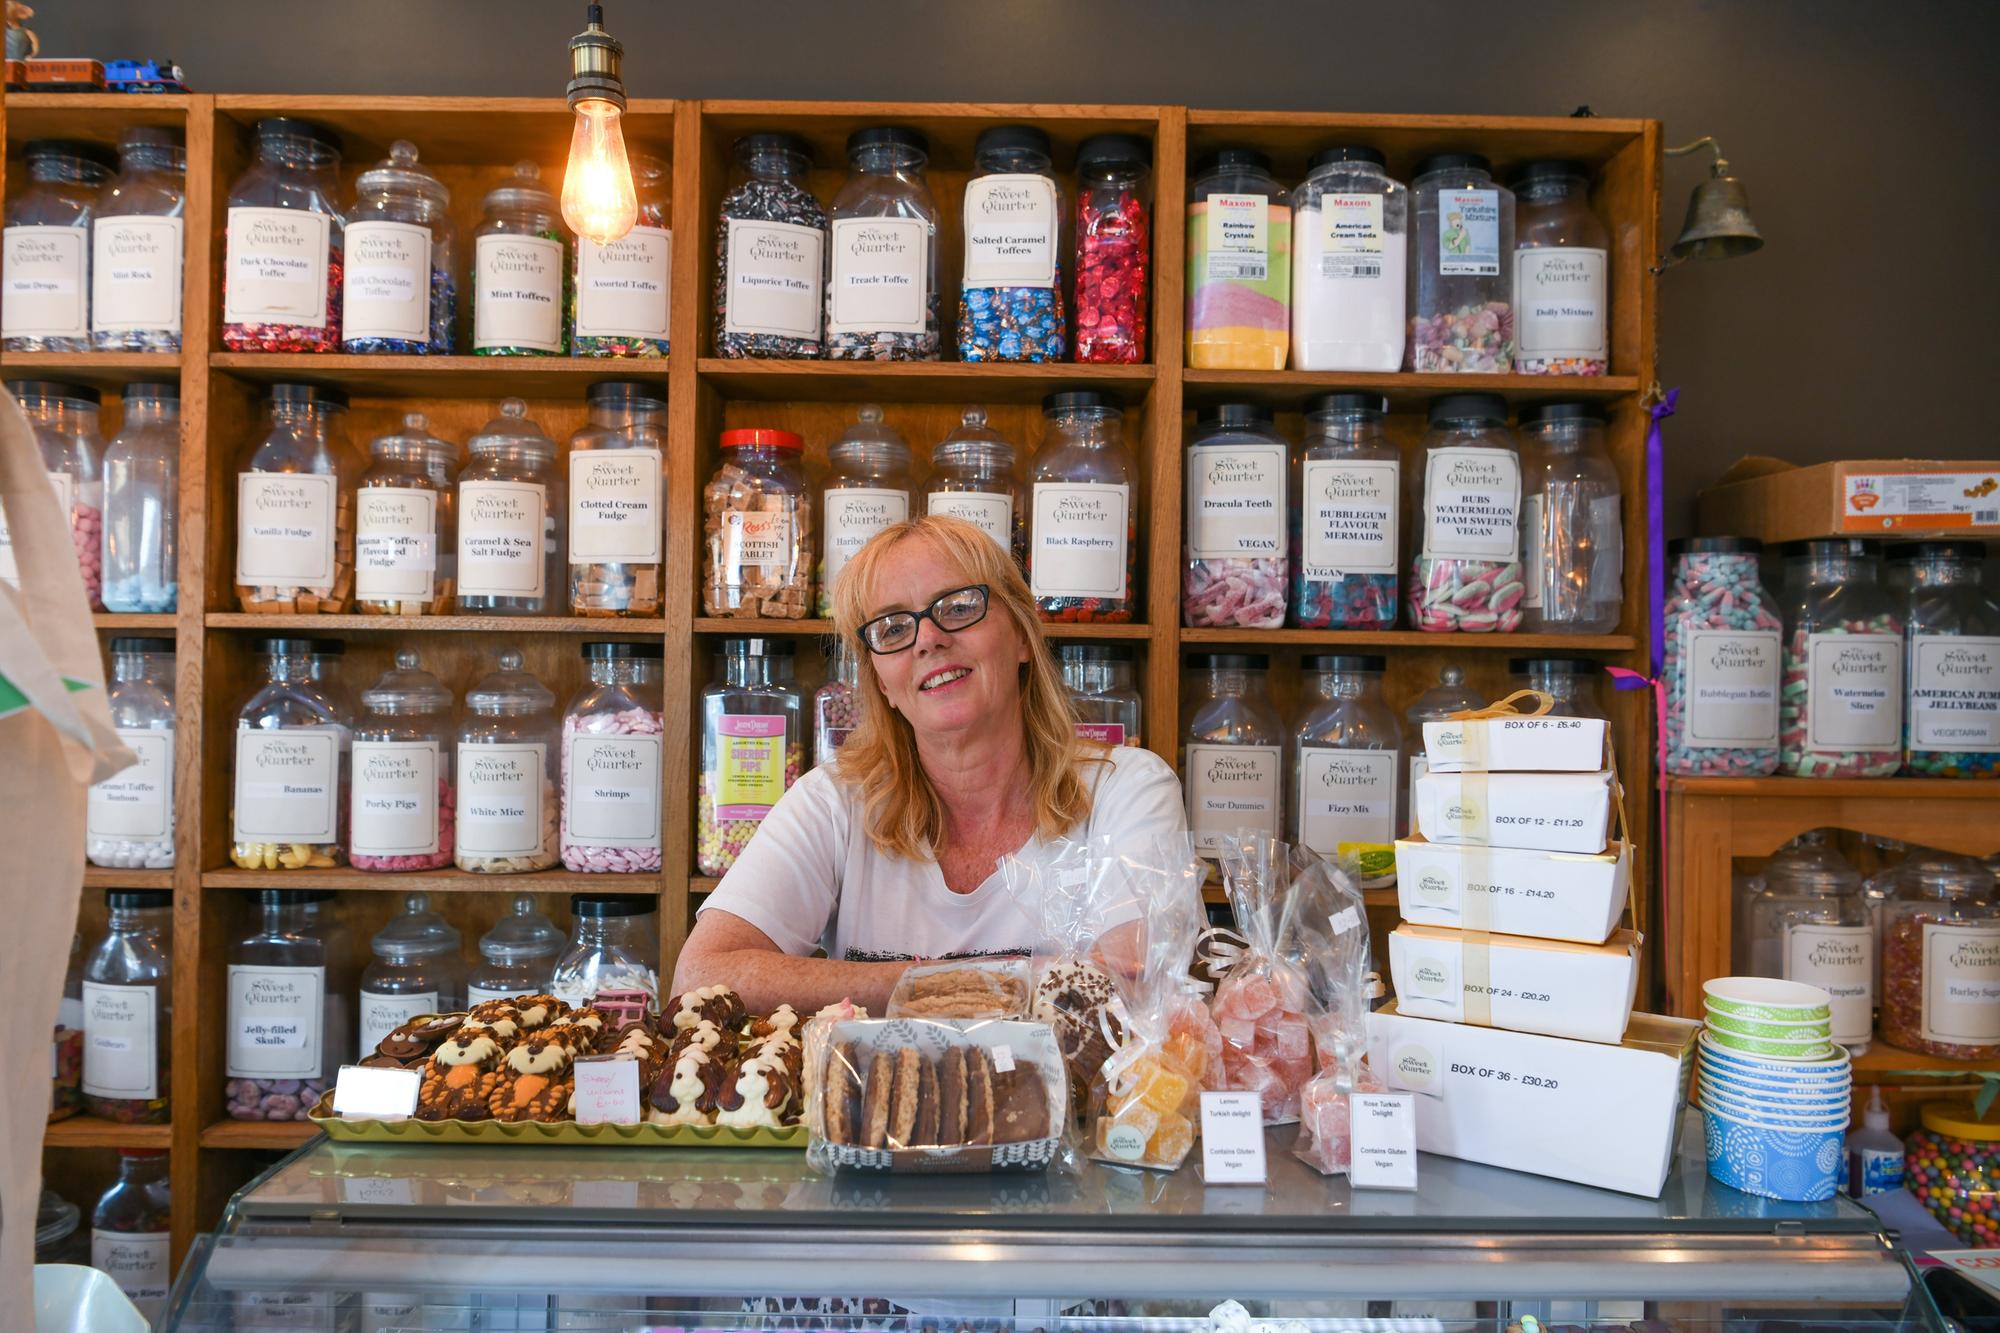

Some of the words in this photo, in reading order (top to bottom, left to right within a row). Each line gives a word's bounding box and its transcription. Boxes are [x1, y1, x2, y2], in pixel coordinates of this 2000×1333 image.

[987, 188, 1031, 200] Sweet
[981, 200, 1037, 214] Quarter
[1219, 199, 1257, 208] Maxons
[1333, 198, 1372, 208] Maxons
[1464, 213, 1498, 222] Mixture
[1222, 222, 1256, 230] Rainbow
[1335, 222, 1372, 230] American
[857, 231, 900, 242] Sweet
[972, 235, 1003, 244] Salted
[1004, 235, 1046, 244] Caramel
[1224, 231, 1255, 241] Crystals
[1330, 231, 1355, 239] Cream
[1357, 231, 1377, 239] Soda
[757, 236, 800, 250] Sweet
[850, 242, 906, 256] Quarter
[995, 246, 1032, 255] Toffees
[749, 247, 805, 264] Quarter
[263, 258, 308, 269] Chocolate
[259, 268, 286, 278] Toffee
[592, 279, 628, 289] Assorted
[631, 280, 658, 291] Toffee
[742, 275, 782, 287] Liquorice
[785, 279, 811, 290] Toffee
[849, 276, 880, 285] Treacle
[882, 275, 910, 284] Toffee
[490, 290, 513, 299] Mint
[516, 291, 551, 303] Toffees
[1536, 308, 1559, 318] Dolly
[1561, 307, 1594, 317] Mixture
[591, 464, 634, 475] Sweet
[1215, 459, 1259, 472] Sweet
[1453, 462, 1497, 474] Sweet
[586, 475, 641, 489] Quarter
[1208, 471, 1265, 486] Quarter
[1330, 474, 1375, 487] Sweet
[1446, 473, 1503, 488] Quarter
[1324, 486, 1382, 501] Quarter
[580, 500, 614, 510] Clotted
[614, 500, 649, 511] Cream
[1059, 497, 1103, 510] Sweet
[1203, 499, 1243, 509] Dracula
[1244, 499, 1273, 509] Teeth
[1461, 495, 1491, 505] BUBS
[844, 502, 888, 515] Sweet
[947, 506, 990, 519] Sweet
[1435, 505, 1513, 516] WATERMELON
[598, 511, 628, 522] Fudge
[1052, 509, 1108, 523] Quarter
[1320, 509, 1387, 520] BUBBLEGUM
[1328, 519, 1380, 530] FLAVOUR
[1436, 515, 1468, 526] FOAM
[1469, 516, 1513, 528] SWEETS
[253, 527, 283, 536] Vanilla
[284, 527, 312, 538] Fudge
[1324, 530, 1384, 541] MERMAIDS
[1455, 527, 1493, 537] VEGAN
[465, 536, 502, 546] Caramel
[503, 537, 511, 545] &
[514, 537, 532, 547] Sea
[836, 537, 865, 546] Haribo
[1046, 537, 1070, 546] Black
[1071, 537, 1115, 548] Raspberry
[1238, 538, 1276, 549] VEGAN
[471, 547, 489, 557] Salt
[490, 547, 523, 559] Fudge
[1305, 567, 1344, 578] VEGAN
[1831, 661, 1888, 676] Quarter
[1936, 662, 1993, 678] Quarter
[1833, 687, 1886, 698] Watermelon
[1911, 688, 1976, 699] AMERICAN
[1849, 700, 1875, 711] Slices
[1928, 700, 1998, 711] JELLYBEANS
[1504, 720, 1525, 730] BOX
[1526, 720, 1541, 730] OF
[1542, 720, 1549, 730] 6
[1557, 720, 1582, 730] £6.40
[1931, 727, 1988, 738] VEGETARIAN
[592, 746, 637, 759] Sweet
[586, 758, 642, 773] Quarter
[1213, 757, 1258, 770] Sweet
[1328, 762, 1373, 775] Sweet
[469, 769, 524, 785] Quarter
[1207, 769, 1264, 783] Quarter
[1321, 773, 1379, 788] Quarter
[594, 788, 631, 800] Shrimps
[365, 799, 392, 811] Porky
[394, 799, 418, 811] Pigs
[1206, 799, 1226, 809] Sour
[1227, 800, 1266, 811] Dummies
[1328, 803, 1351, 814] Fizzy
[1353, 804, 1370, 813] Mix
[470, 806, 498, 817] White
[499, 806, 525, 817] Mice
[1495, 815, 1516, 825] BOX
[1517, 816, 1533, 826] OF
[1534, 817, 1546, 827] 12
[1552, 818, 1584, 828] £11.20
[1466, 882, 1488, 893] BOX
[1488, 885, 1503, 895] OF
[1504, 886, 1516, 896] 16
[1525, 889, 1556, 900] £14.20
[1808, 953, 1865, 968] Quarter
[1463, 983, 1485, 994] BOX
[1485, 986, 1502, 996] OF
[1501, 987, 1513, 998] 24
[1520, 991, 1551, 1003] £20.20
[1949, 985, 1980, 998] Barley
[244, 1024, 297, 1037] Jelly-filled
[254, 1036, 286, 1046] Skulls
[1450, 1062, 1477, 1077] BOX
[1478, 1067, 1496, 1079] OF
[1496, 1071, 1512, 1082] 36
[1521, 1074, 1559, 1091] £30.20
[1363, 1100, 1379, 1108] Rose
[1380, 1100, 1402, 1109] Turkish
[1231, 1110, 1252, 1119] delight
[1371, 1109, 1393, 1118] Delight
[1236, 1147, 1256, 1155] Gluten
[1360, 1146, 1387, 1155] Contains
[1387, 1147, 1408, 1155] Gluten
[1224, 1161, 1243, 1169] Vegan
[1374, 1160, 1394, 1169] Vegan
